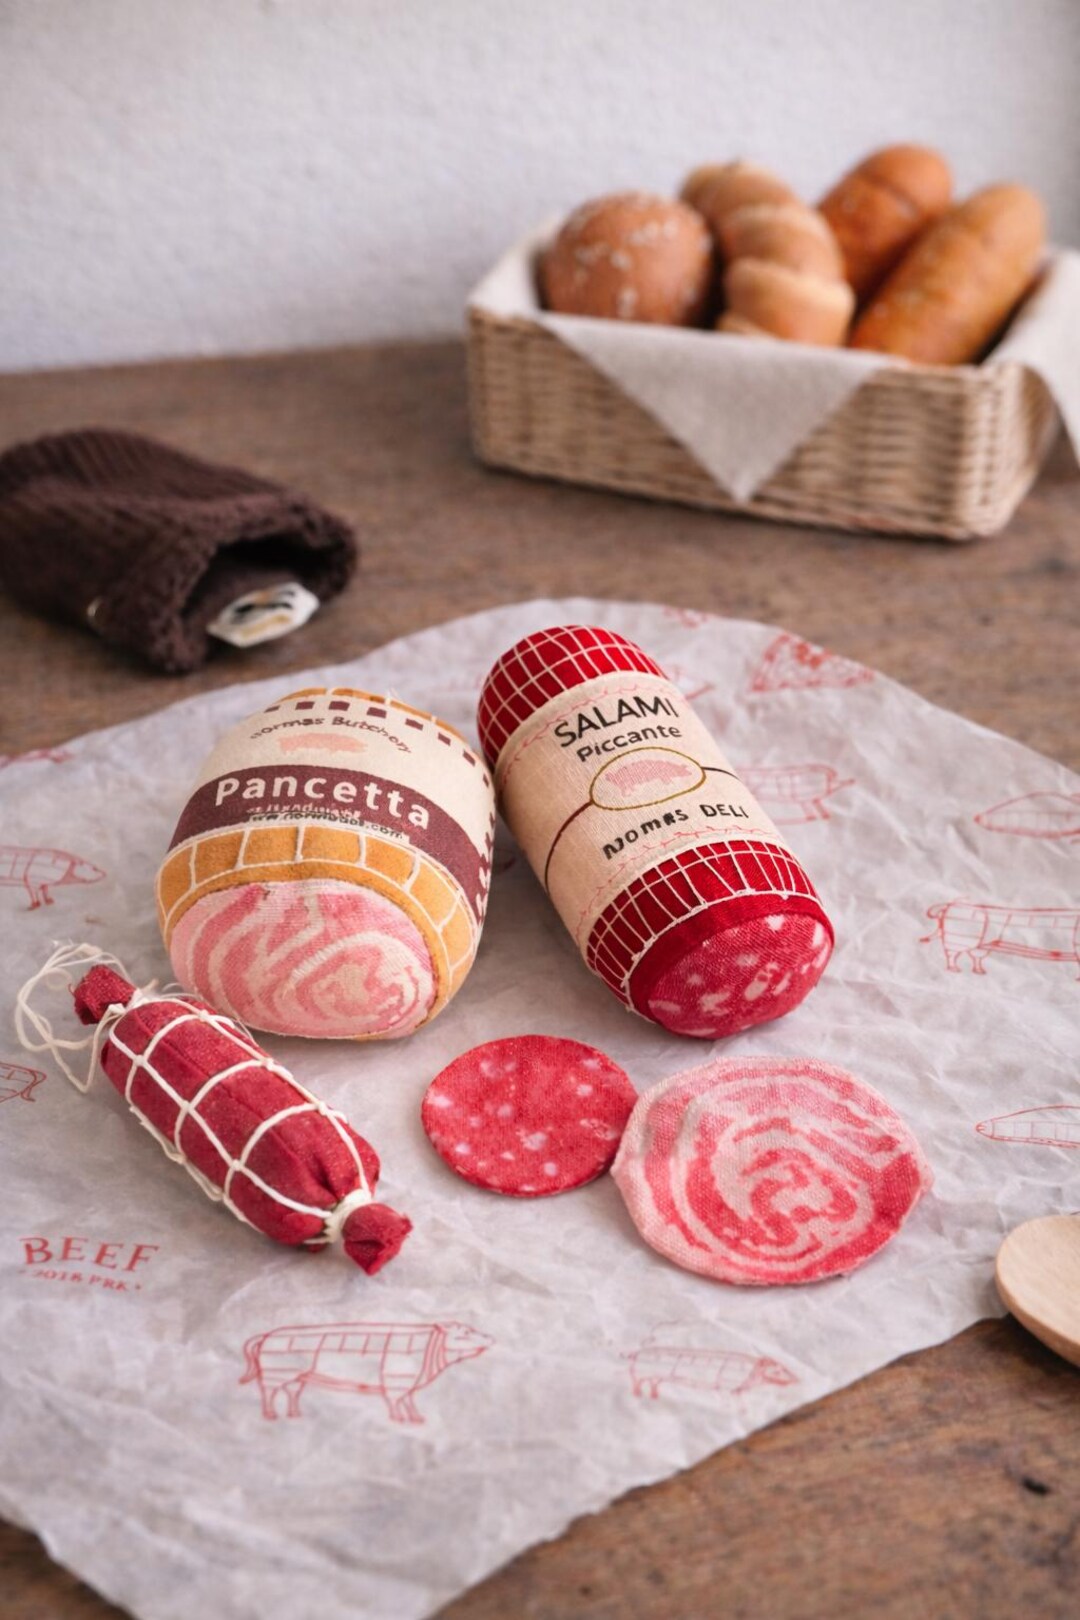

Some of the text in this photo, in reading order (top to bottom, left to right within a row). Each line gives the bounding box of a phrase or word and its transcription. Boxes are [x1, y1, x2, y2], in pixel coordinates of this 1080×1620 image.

[554, 695, 679, 748] SALAMI
[577, 724, 682, 762] Piccante
[699, 803, 749, 819] DELI
[20, 1236, 160, 1272] BEEF
